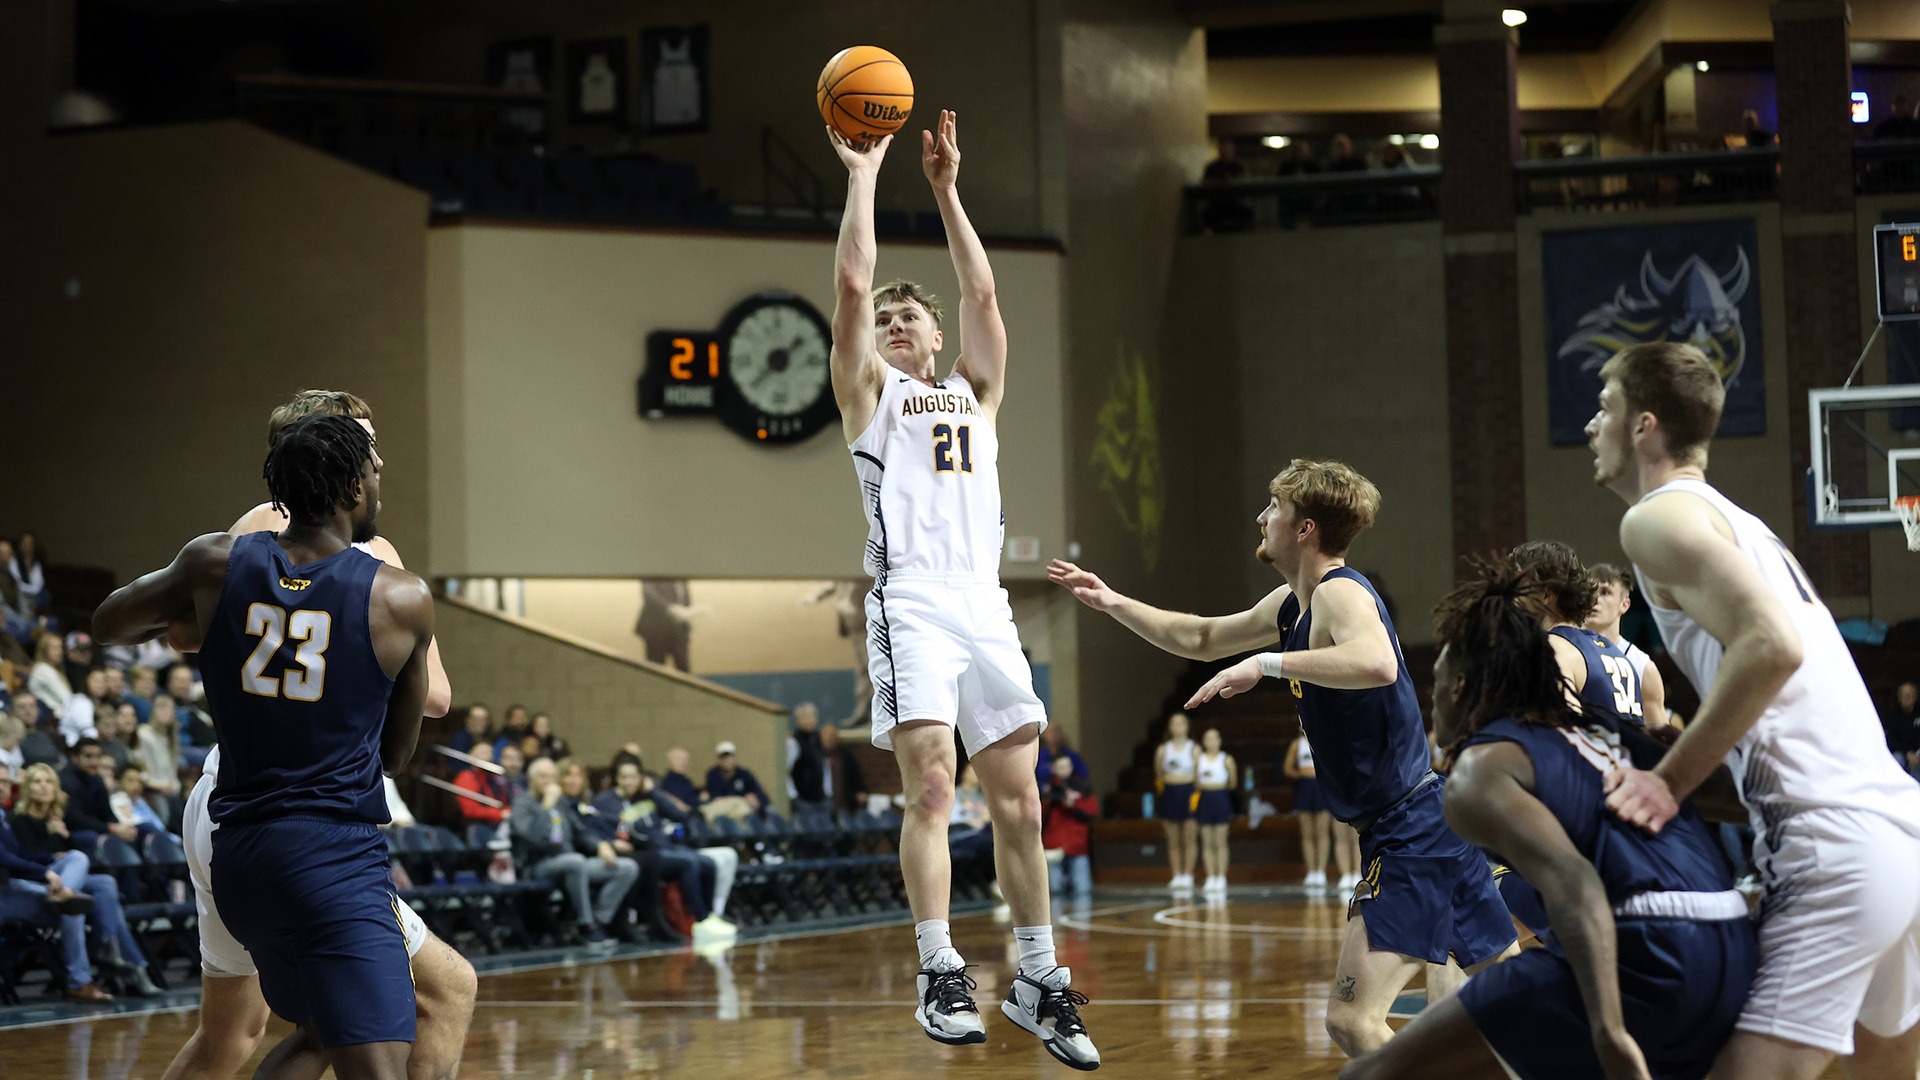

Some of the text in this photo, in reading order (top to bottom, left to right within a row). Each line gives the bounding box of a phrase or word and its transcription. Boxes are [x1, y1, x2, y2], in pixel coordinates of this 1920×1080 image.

[669, 337, 720, 380] 21
[931, 421, 974, 475] 21
[279, 576, 312, 591] CSP
[241, 601, 332, 702] 23
[1600, 653, 1643, 717] 32
